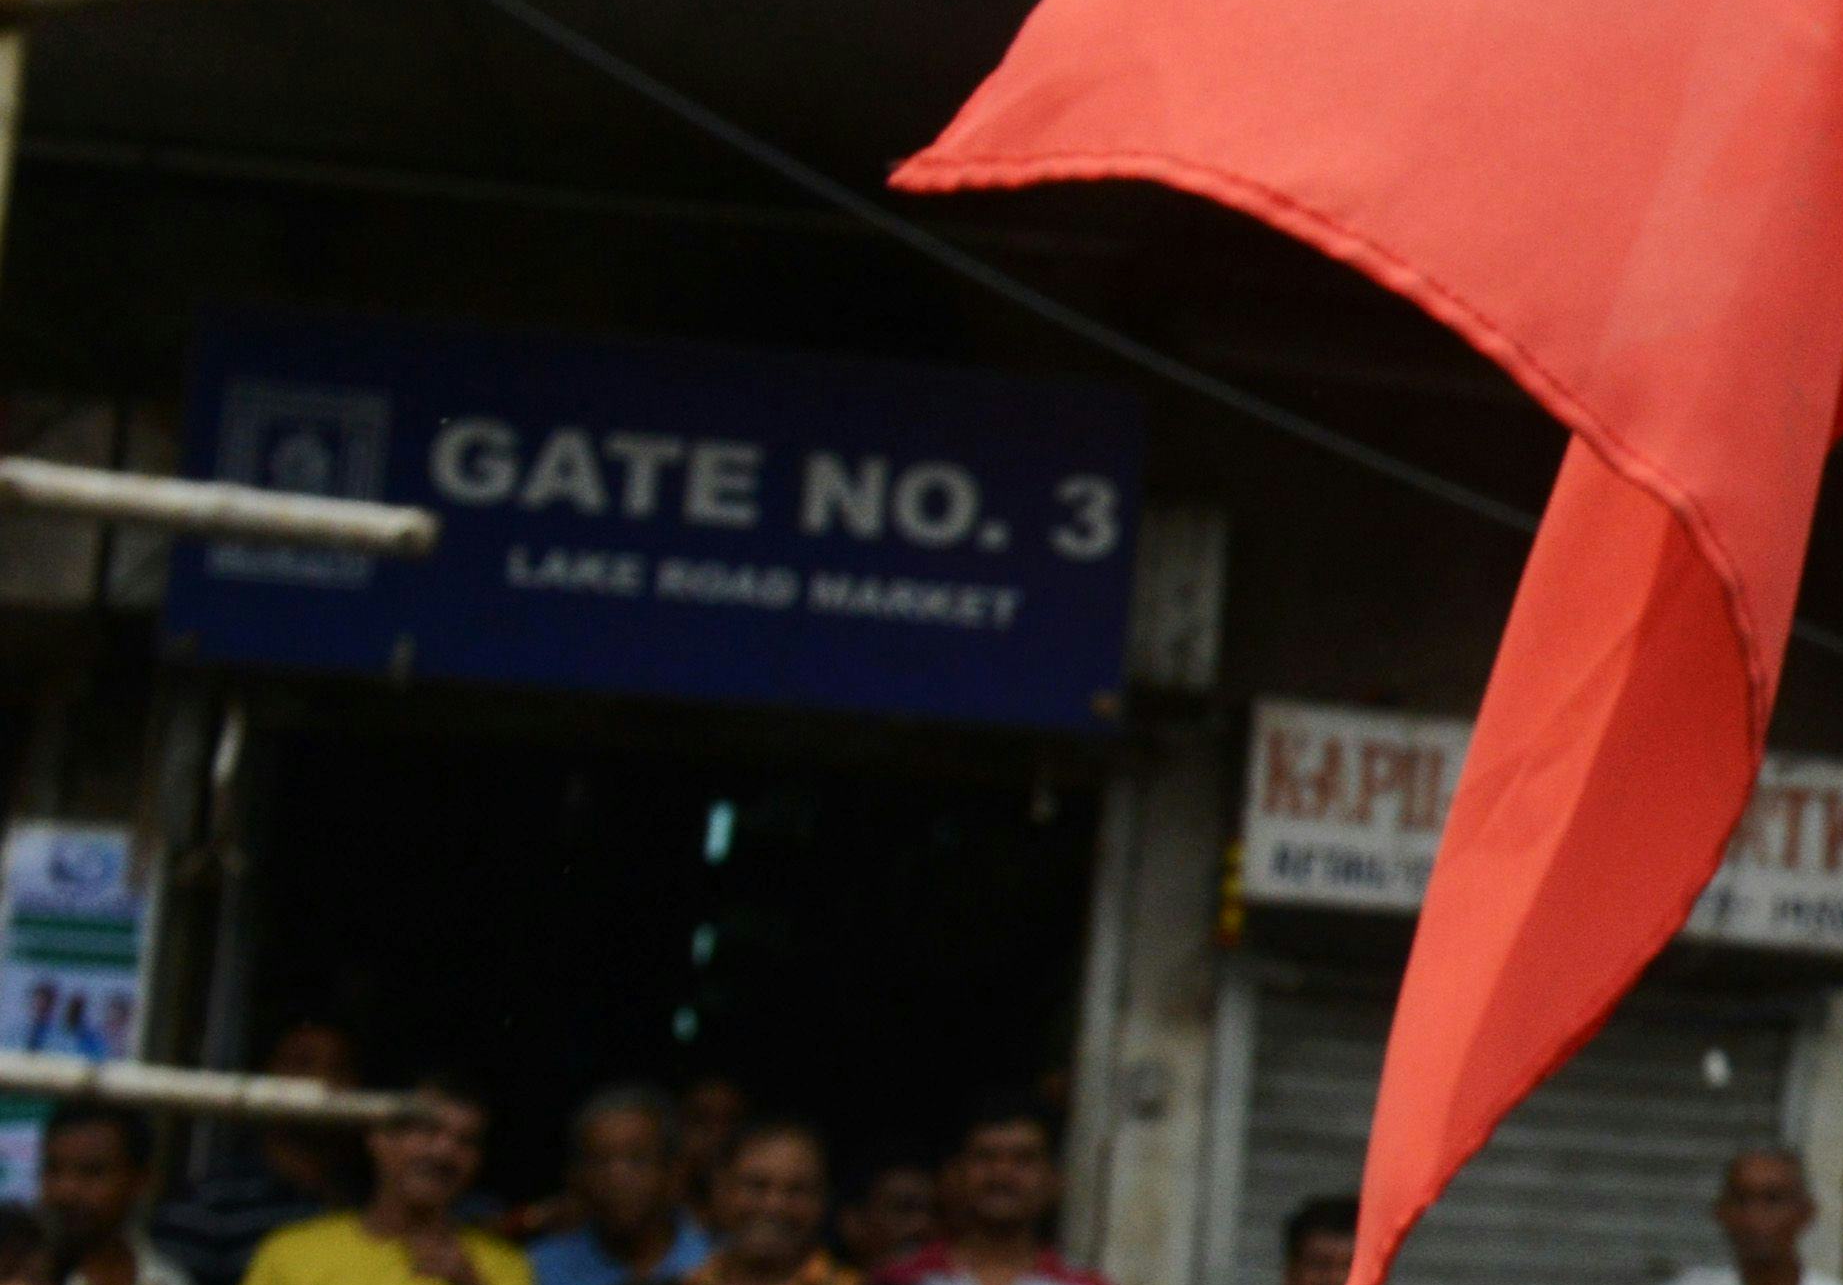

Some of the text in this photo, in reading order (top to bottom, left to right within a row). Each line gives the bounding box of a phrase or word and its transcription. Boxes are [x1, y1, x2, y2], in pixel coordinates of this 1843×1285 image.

[426, 415, 1122, 564] GATE NO. 3
[504, 544, 1022, 633] LAKE ROAD MARKET
